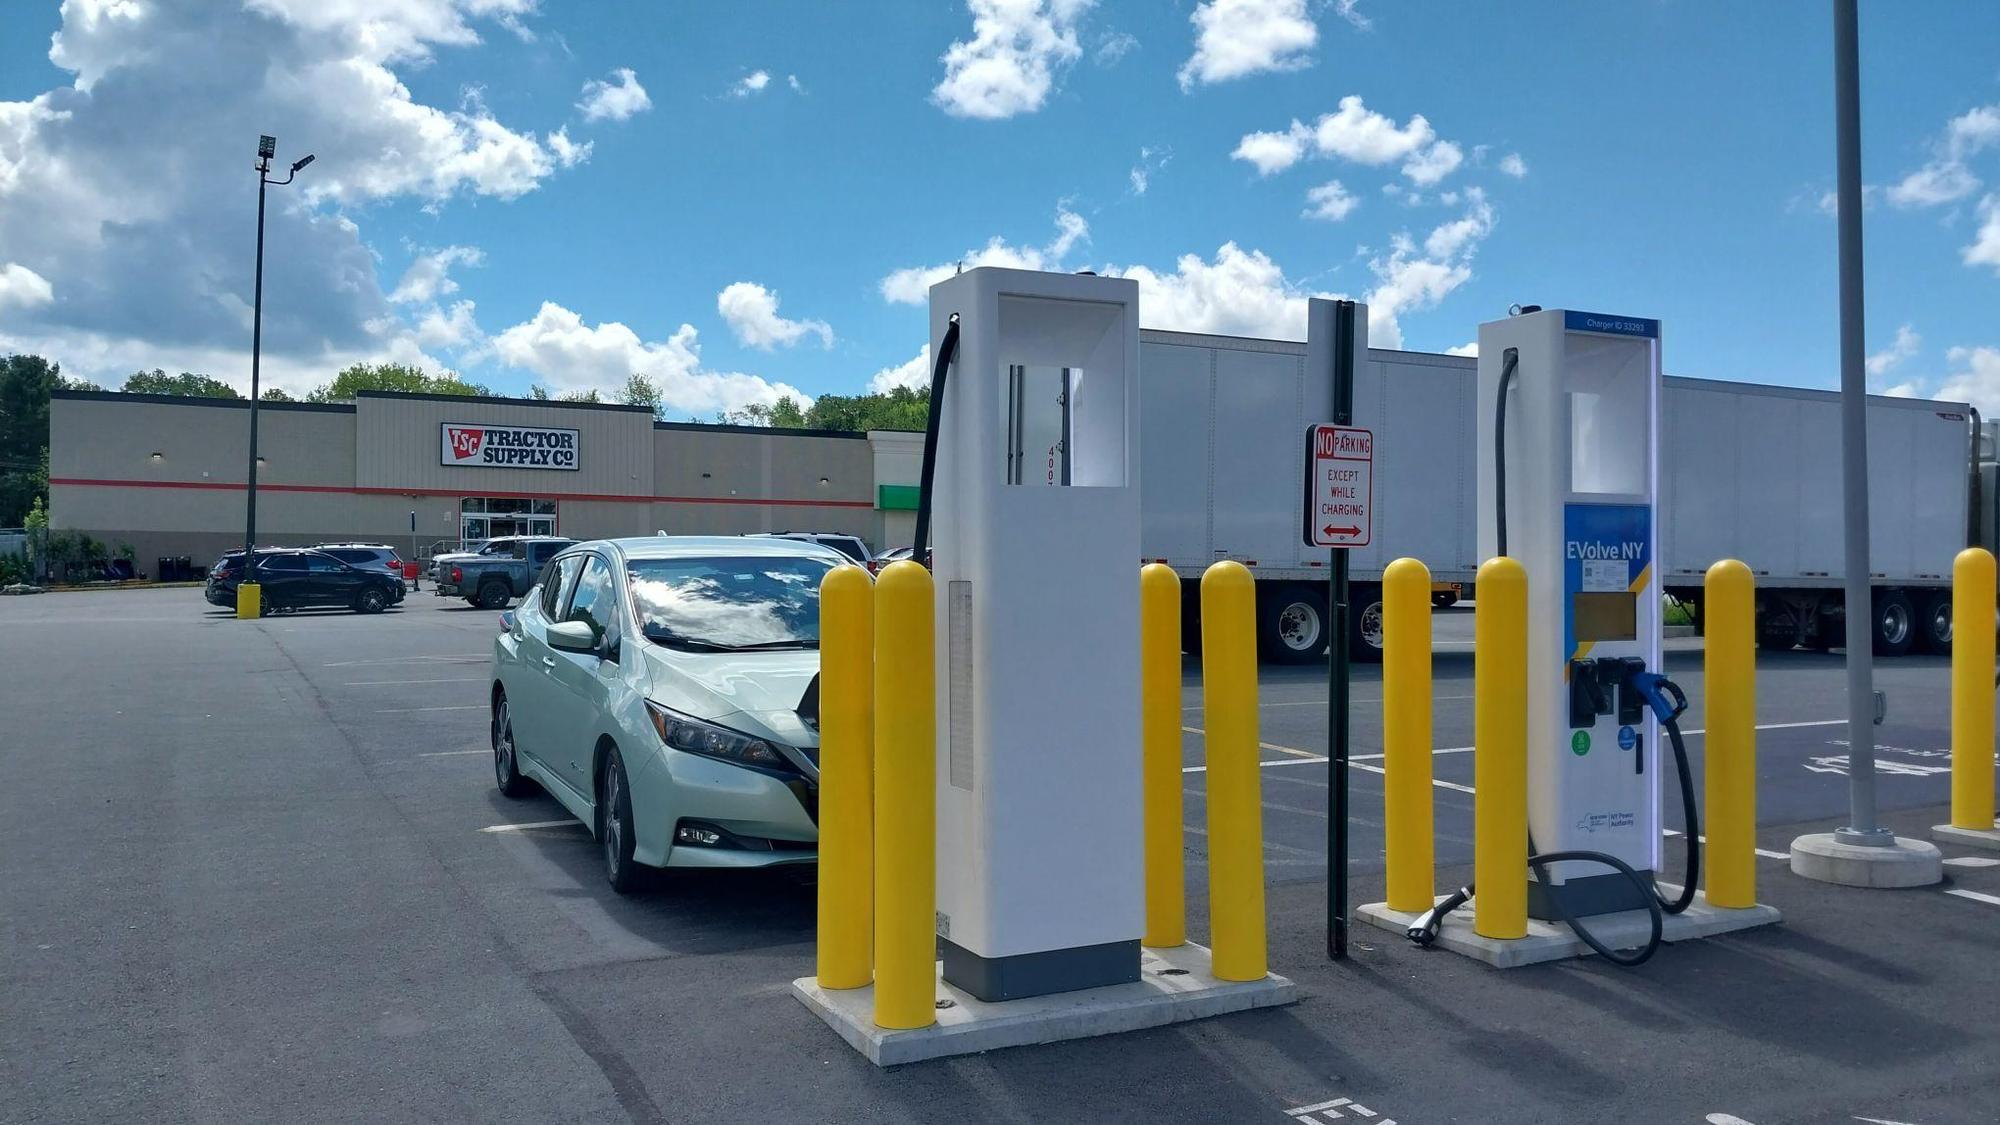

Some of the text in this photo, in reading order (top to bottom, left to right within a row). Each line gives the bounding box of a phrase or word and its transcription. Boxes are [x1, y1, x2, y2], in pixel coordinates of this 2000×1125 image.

[1586, 318, 1613, 330] Charger
[1615, 321, 1622, 330] ID
[452, 430, 478, 455] TSC
[484, 430, 573, 449] TRACTOR
[1317, 432, 1370, 455] NO PARKING
[483, 447, 552, 465] SUPPLY
[1328, 469, 1359, 482] EXCEPT
[1331, 487, 1355, 499] WHILE
[1321, 503, 1364, 516] CHARGING
[1567, 540, 1644, 560] EVolve NY
